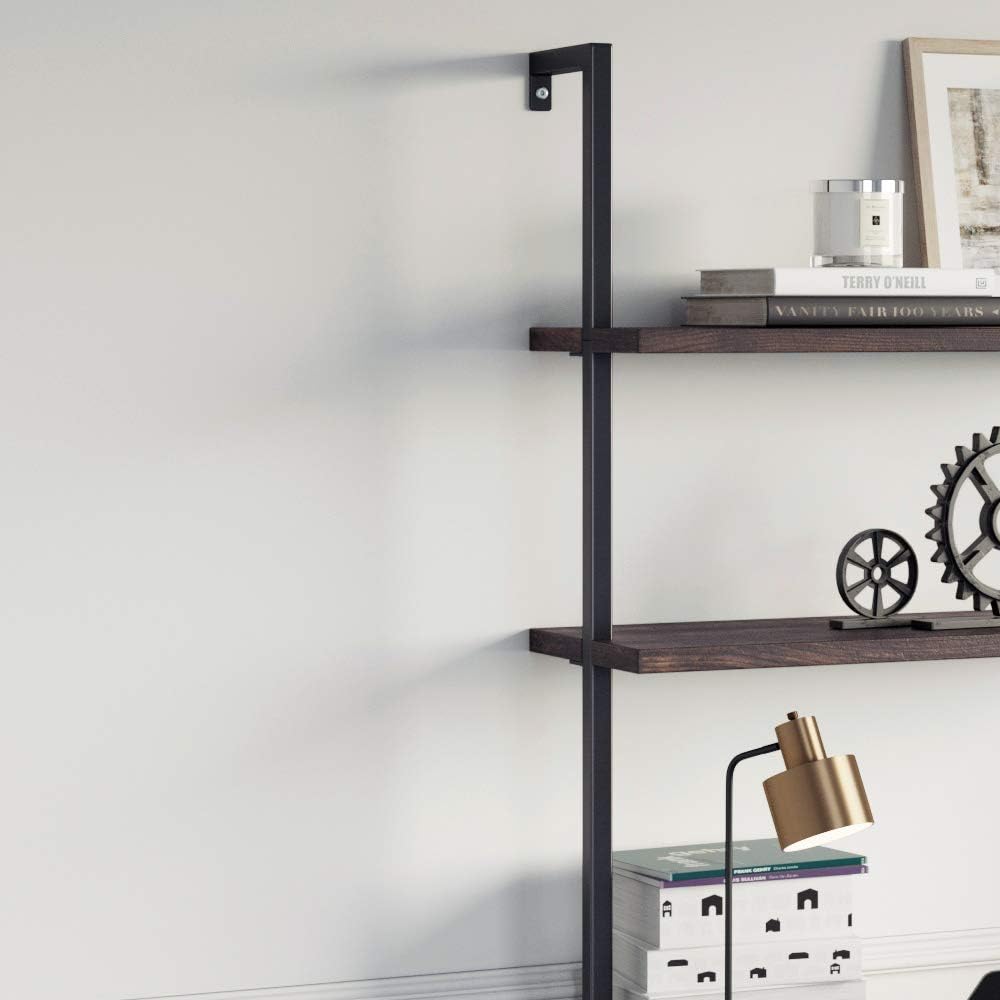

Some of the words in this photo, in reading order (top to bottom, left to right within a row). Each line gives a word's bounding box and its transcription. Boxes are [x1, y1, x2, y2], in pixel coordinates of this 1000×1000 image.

[842, 275, 881, 289] TERRY
[883, 275, 927, 289] O'NEILL
[776, 306, 841, 317] VANITY
[848, 306, 887, 317] FAIR
[929, 306, 984, 317] YEARS
